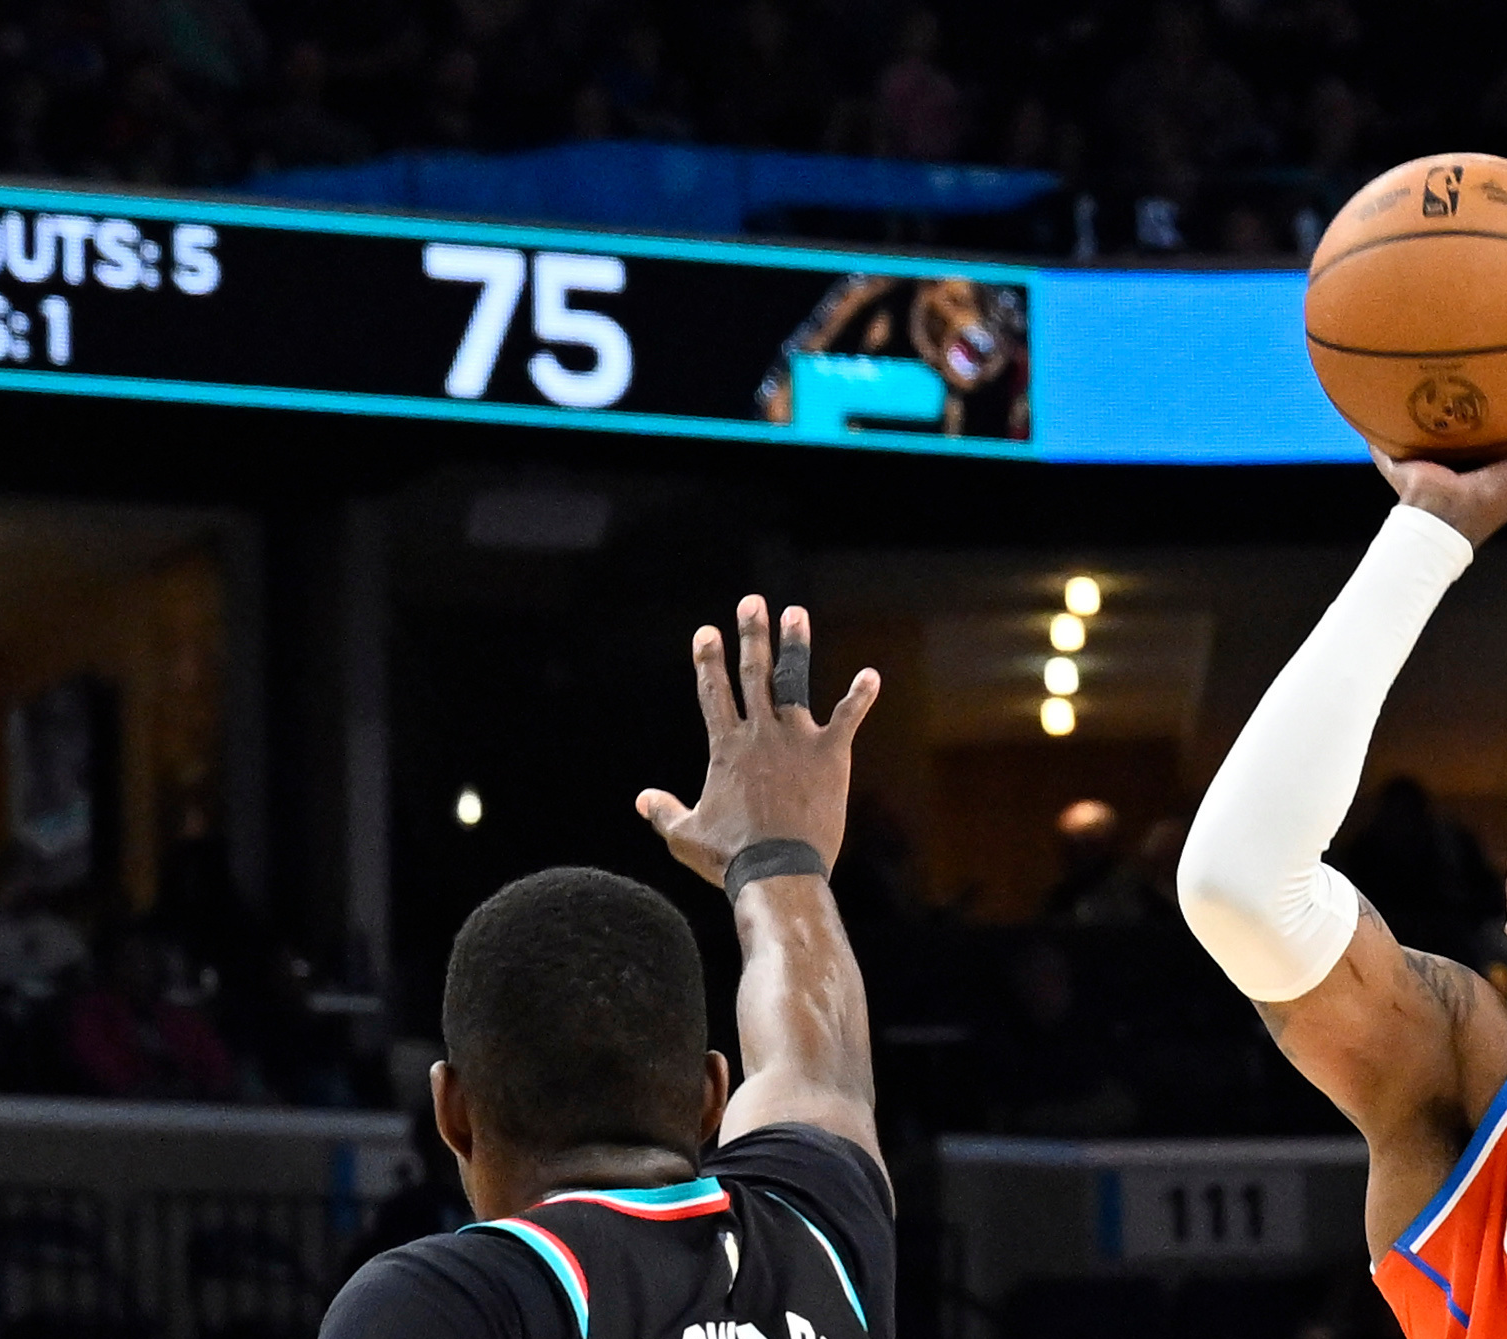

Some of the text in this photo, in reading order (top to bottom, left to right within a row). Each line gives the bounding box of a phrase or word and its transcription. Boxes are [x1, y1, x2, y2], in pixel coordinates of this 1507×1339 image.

[170, 223, 222, 297] 5
[42, 294, 73, 366] 1
[421, 242, 636, 409] 75
[1171, 1182, 1265, 1242] 111
